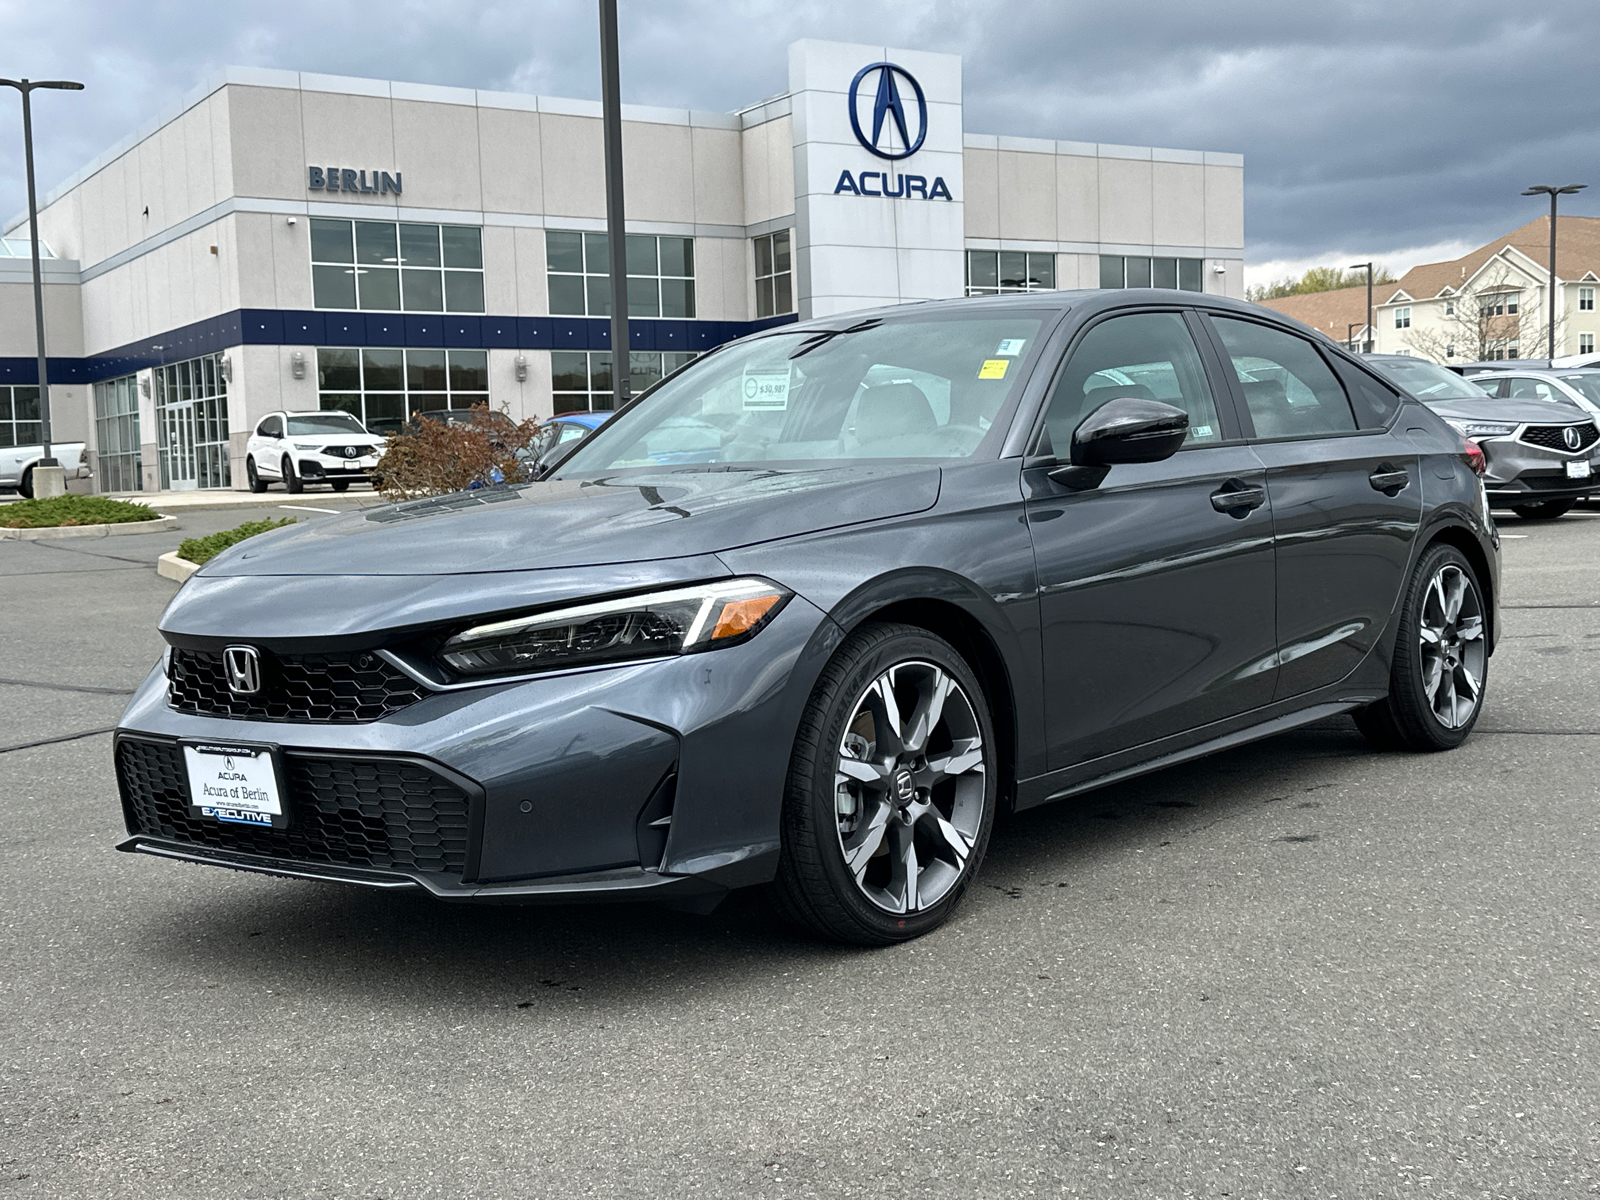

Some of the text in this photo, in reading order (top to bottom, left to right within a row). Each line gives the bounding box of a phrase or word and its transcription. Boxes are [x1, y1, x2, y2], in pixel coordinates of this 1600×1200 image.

[308, 166, 402, 195] BERLIN
[834, 169, 953, 201] ACURA
[760, 383, 786, 395] $30,987
[217, 771, 248, 782] ACURA
[203, 783, 270, 802] Acura of Berlin
[201, 807, 272, 823] EXECUTIVE
